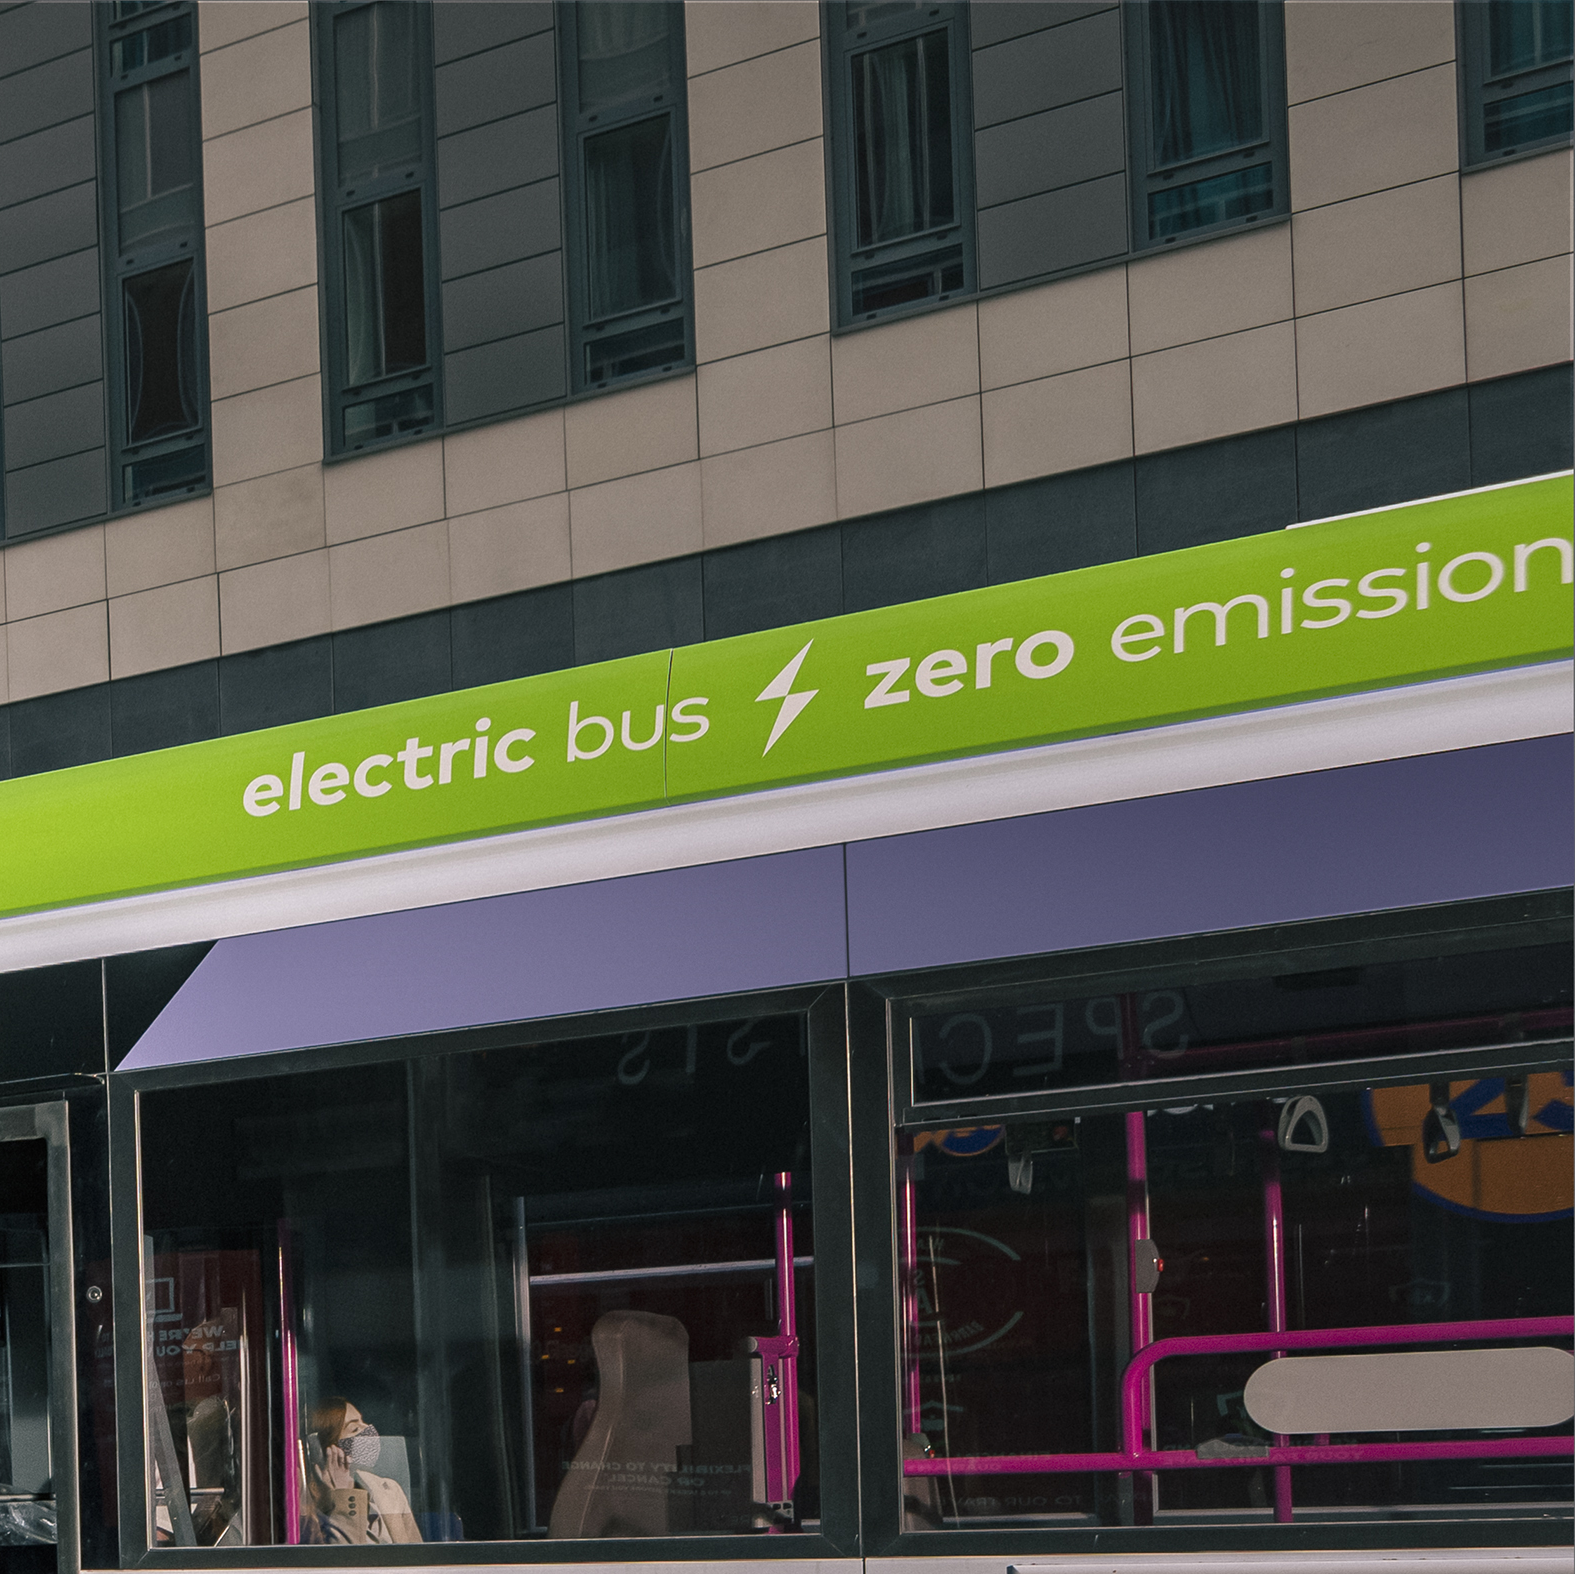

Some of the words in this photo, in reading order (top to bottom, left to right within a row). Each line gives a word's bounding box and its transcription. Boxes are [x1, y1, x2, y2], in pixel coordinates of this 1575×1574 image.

[241, 714, 537, 817] electric
[567, 690, 710, 763] bus
[864, 630, 1075, 709] zero
[1174, 537, 1573, 655] emission
